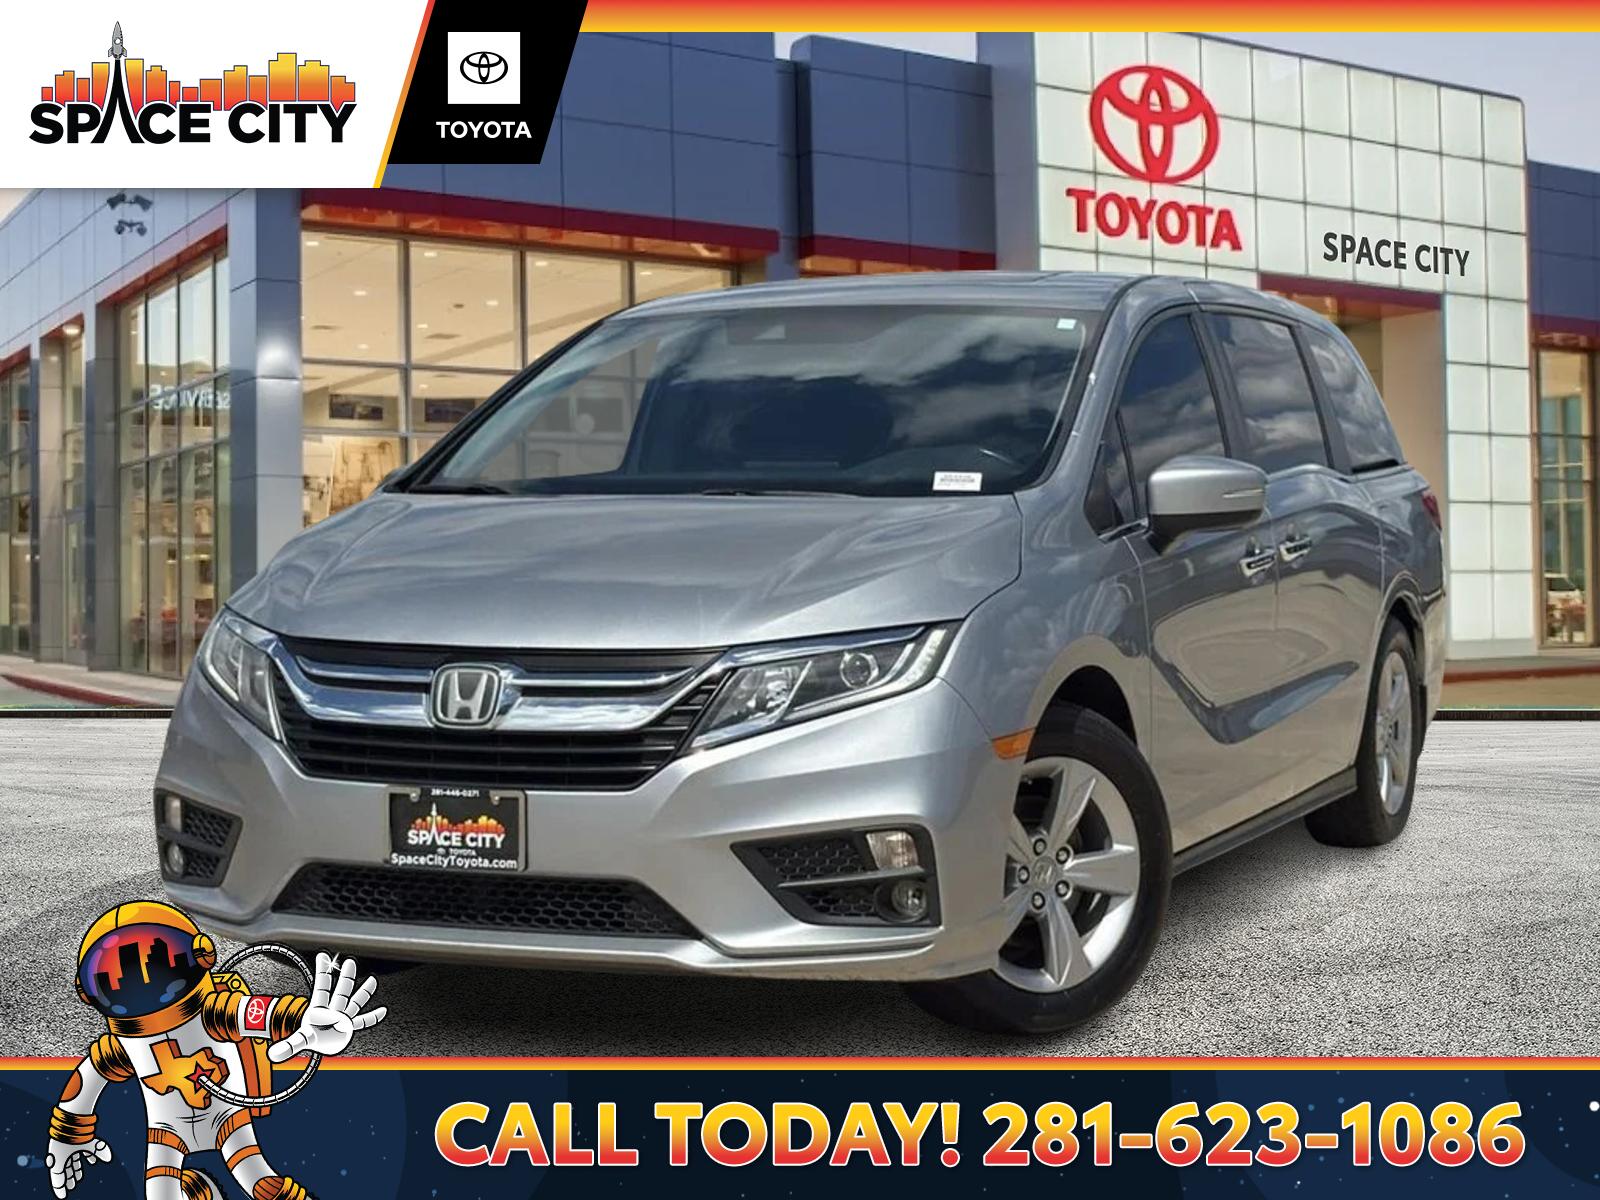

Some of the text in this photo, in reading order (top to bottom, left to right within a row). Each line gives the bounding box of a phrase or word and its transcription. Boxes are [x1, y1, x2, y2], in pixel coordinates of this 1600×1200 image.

[1066, 187, 1242, 251] TOYOTA
[1323, 231, 1471, 277] SPACE CITY
[407, 828, 506, 849] SPACE CITY
[391, 853, 518, 869] SpaceCityToyota.com
